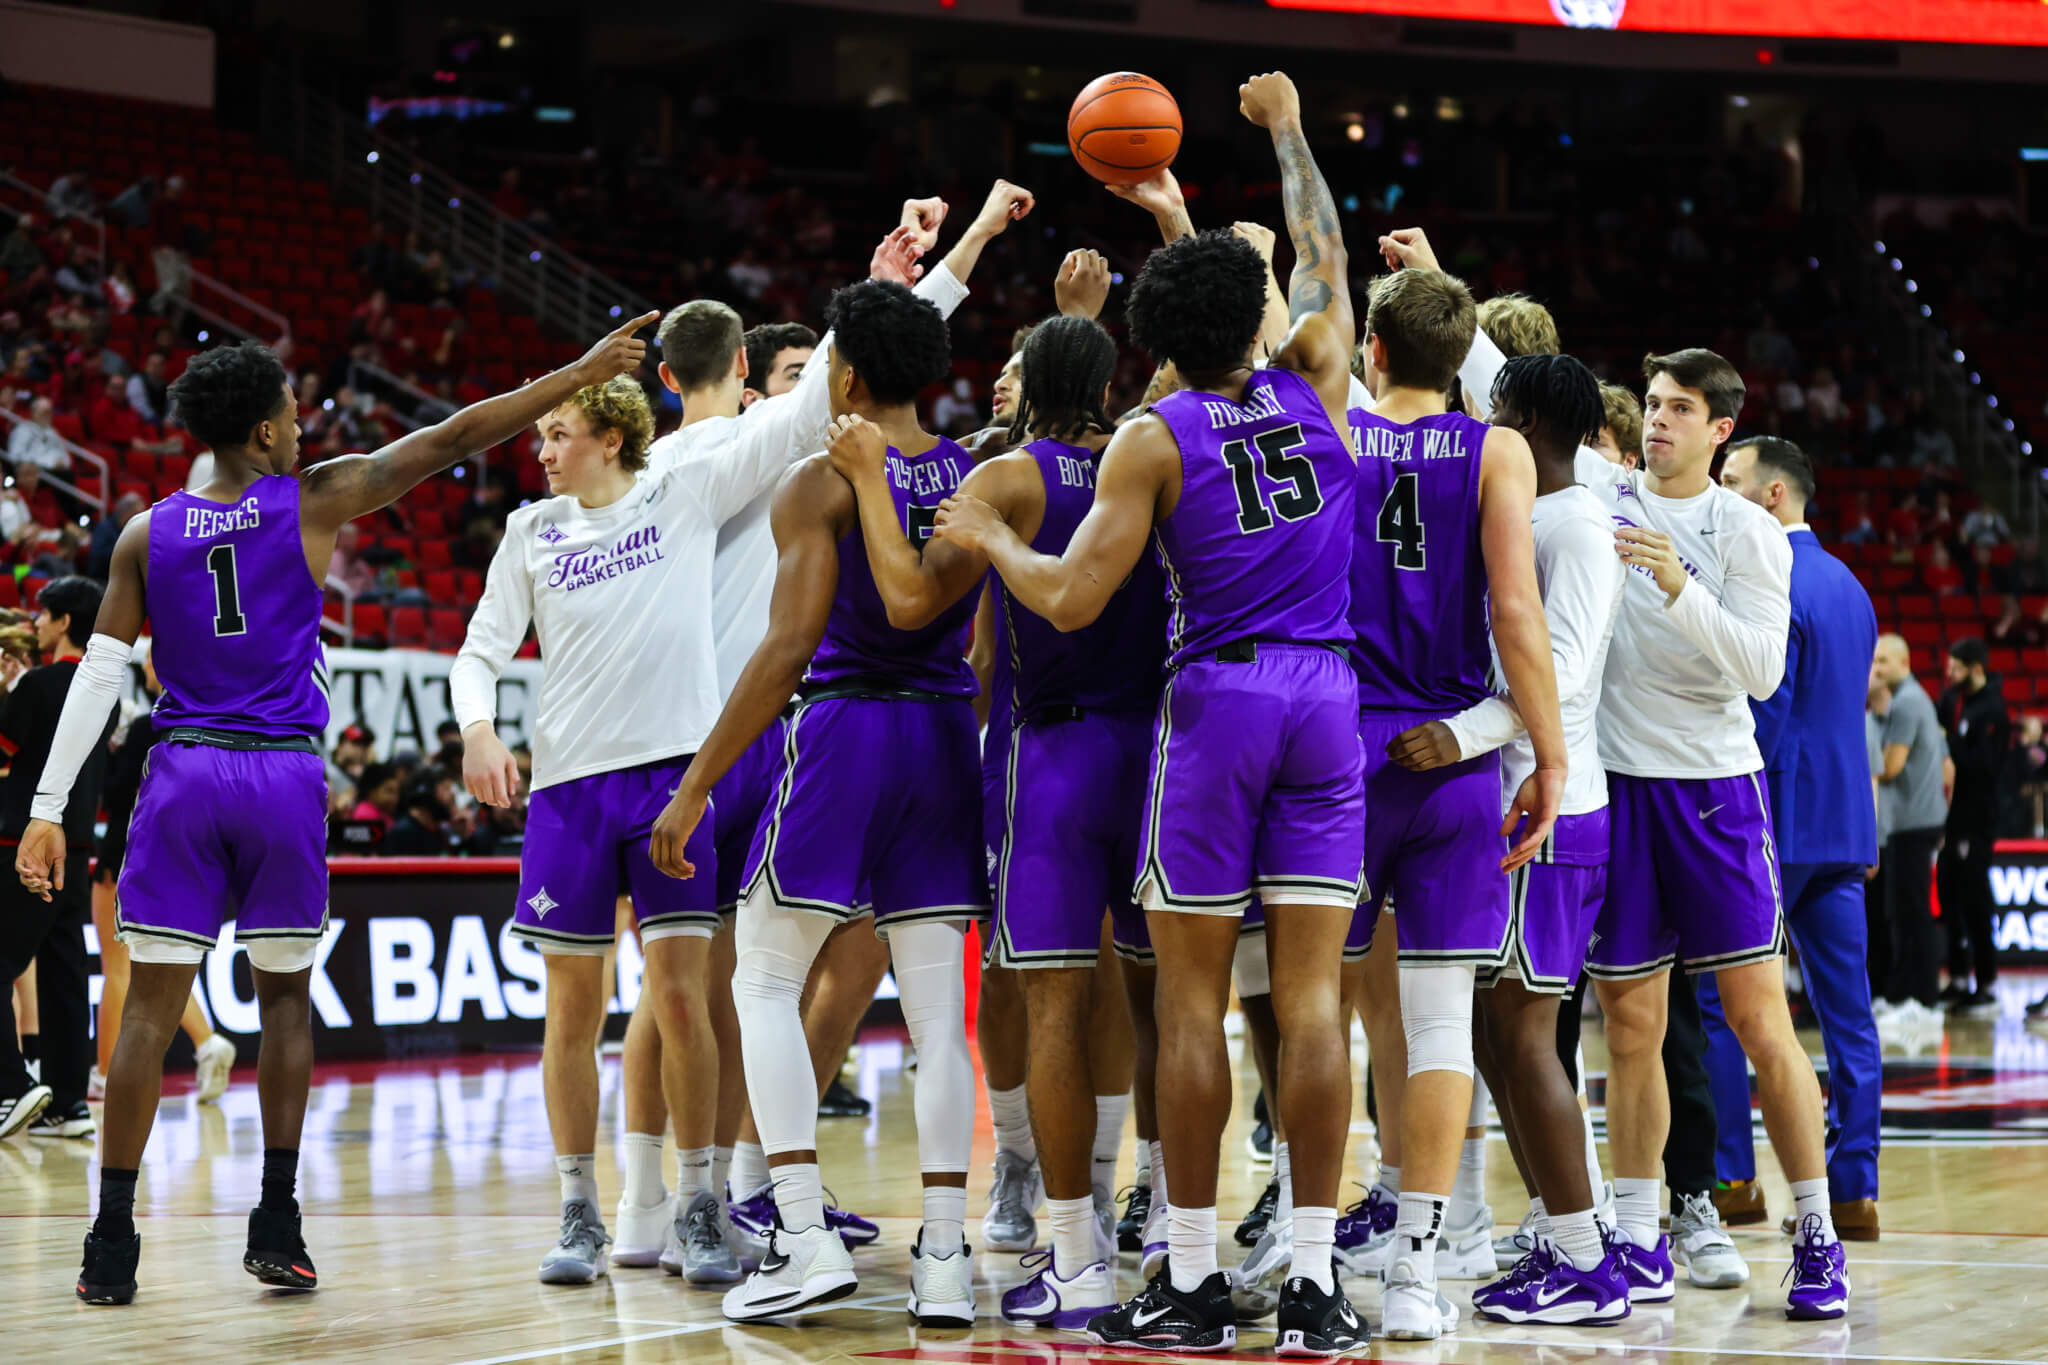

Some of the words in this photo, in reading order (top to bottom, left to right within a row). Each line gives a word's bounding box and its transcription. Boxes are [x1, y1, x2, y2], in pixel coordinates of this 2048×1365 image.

[1423, 428, 1466, 459] WAL
[884, 456, 945, 496] FOSER
[1221, 422, 1325, 535] 15
[184, 497, 260, 538] PEGUES
[1376, 472, 1426, 571] 4
[206, 543, 247, 637] 1
[566, 547, 665, 591] BASKETBALL
[320, 668, 530, 758] TATE
[1992, 911, 2048, 951] AS
